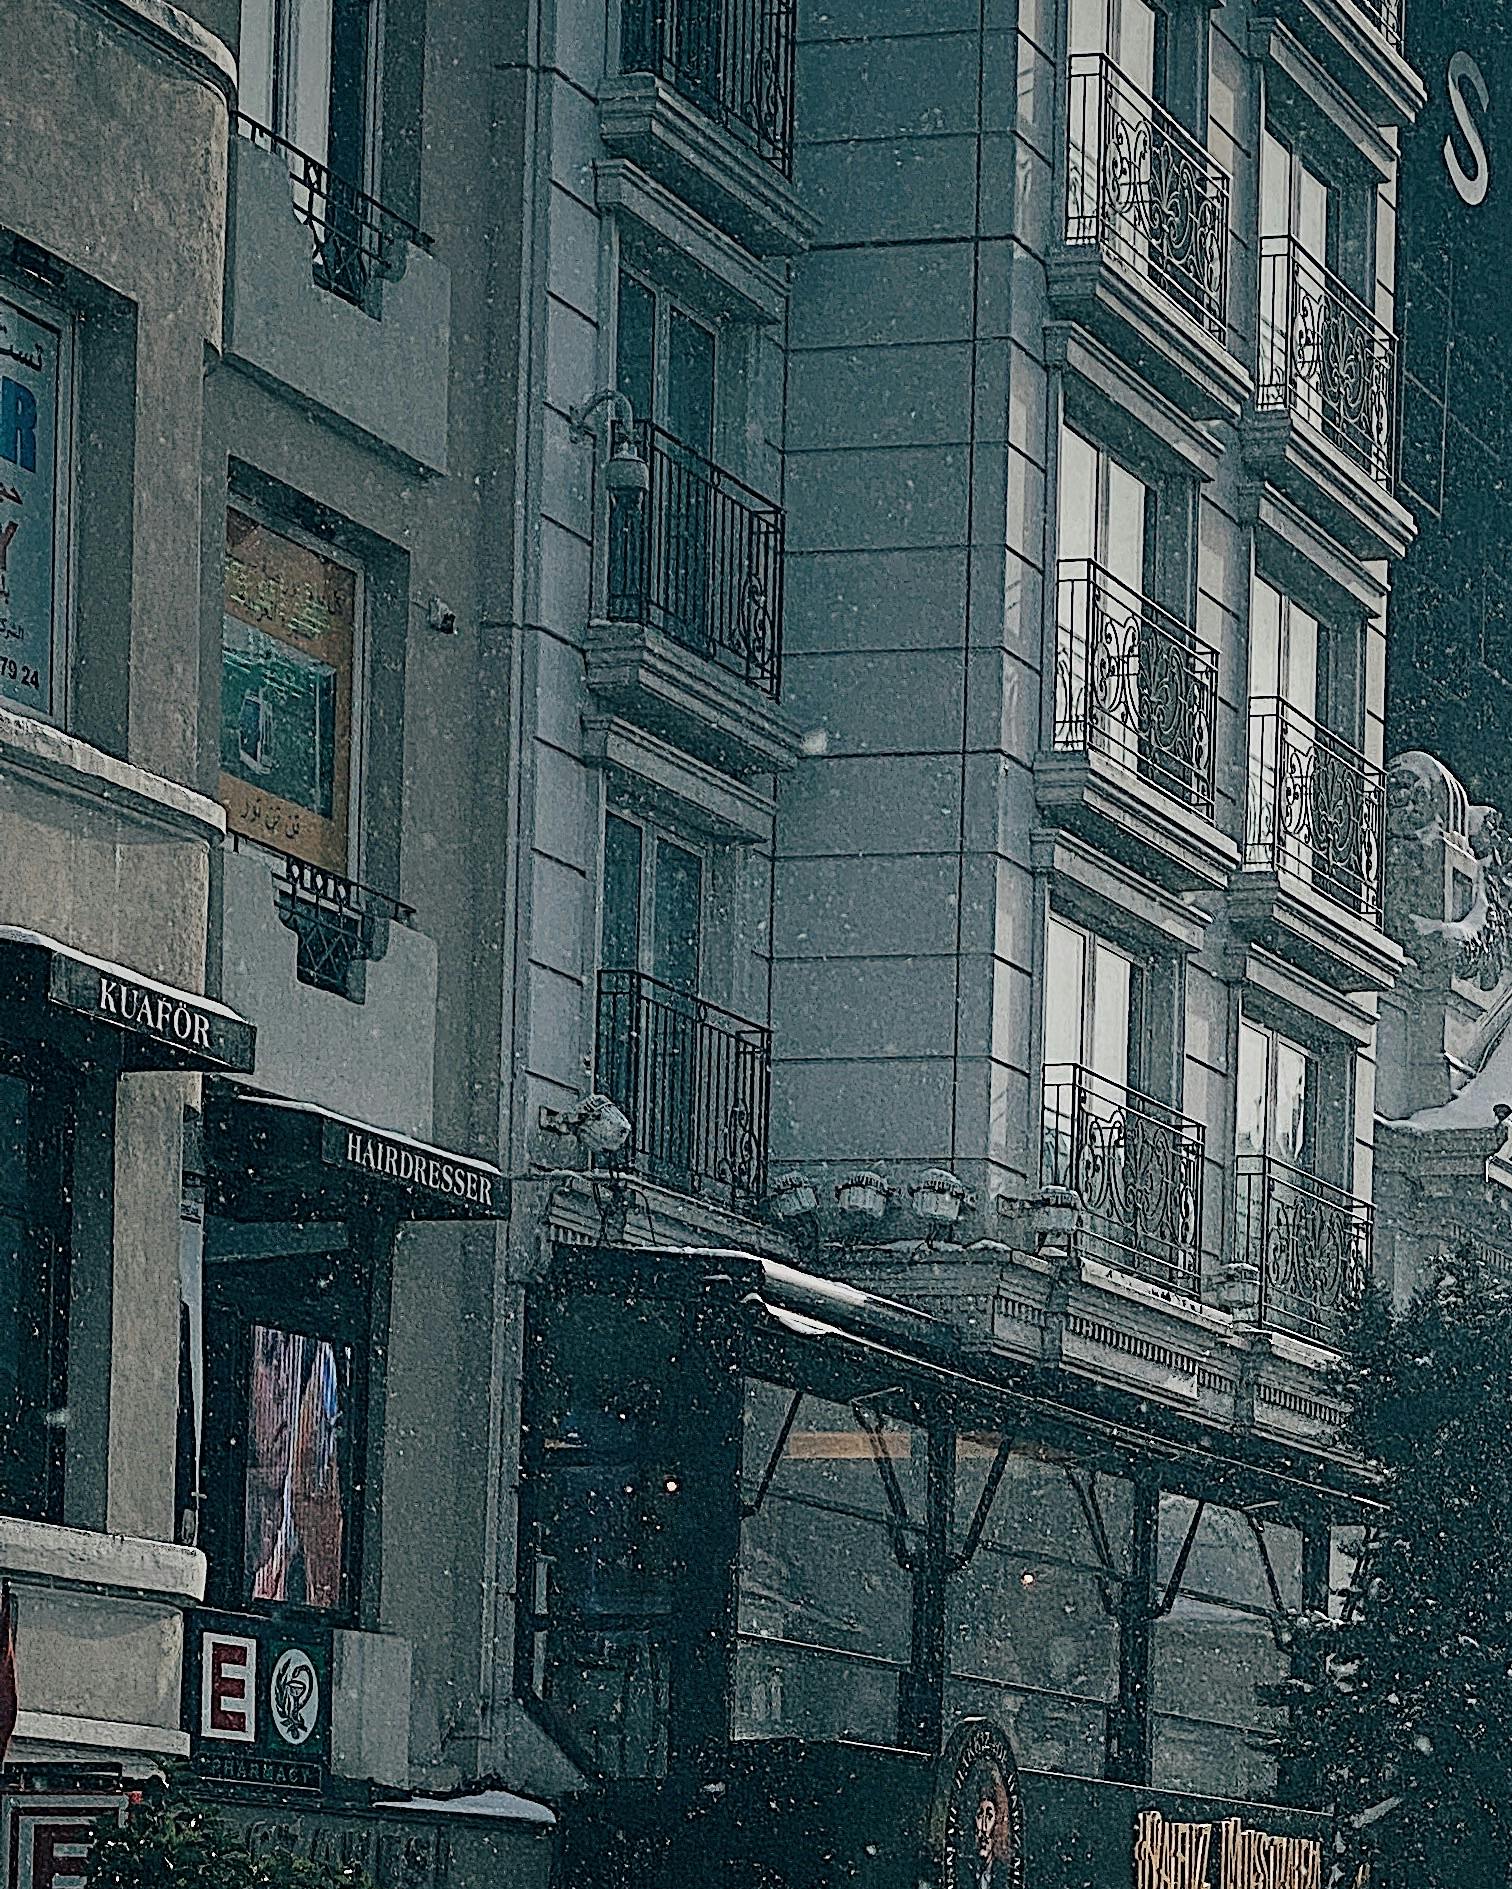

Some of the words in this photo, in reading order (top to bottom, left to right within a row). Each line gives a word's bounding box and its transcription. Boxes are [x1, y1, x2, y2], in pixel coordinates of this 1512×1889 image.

[100, 977, 210, 1049] KUAFÖR
[346, 1132, 493, 1206] HAIRDRESSER
[210, 1640, 248, 1734] E
